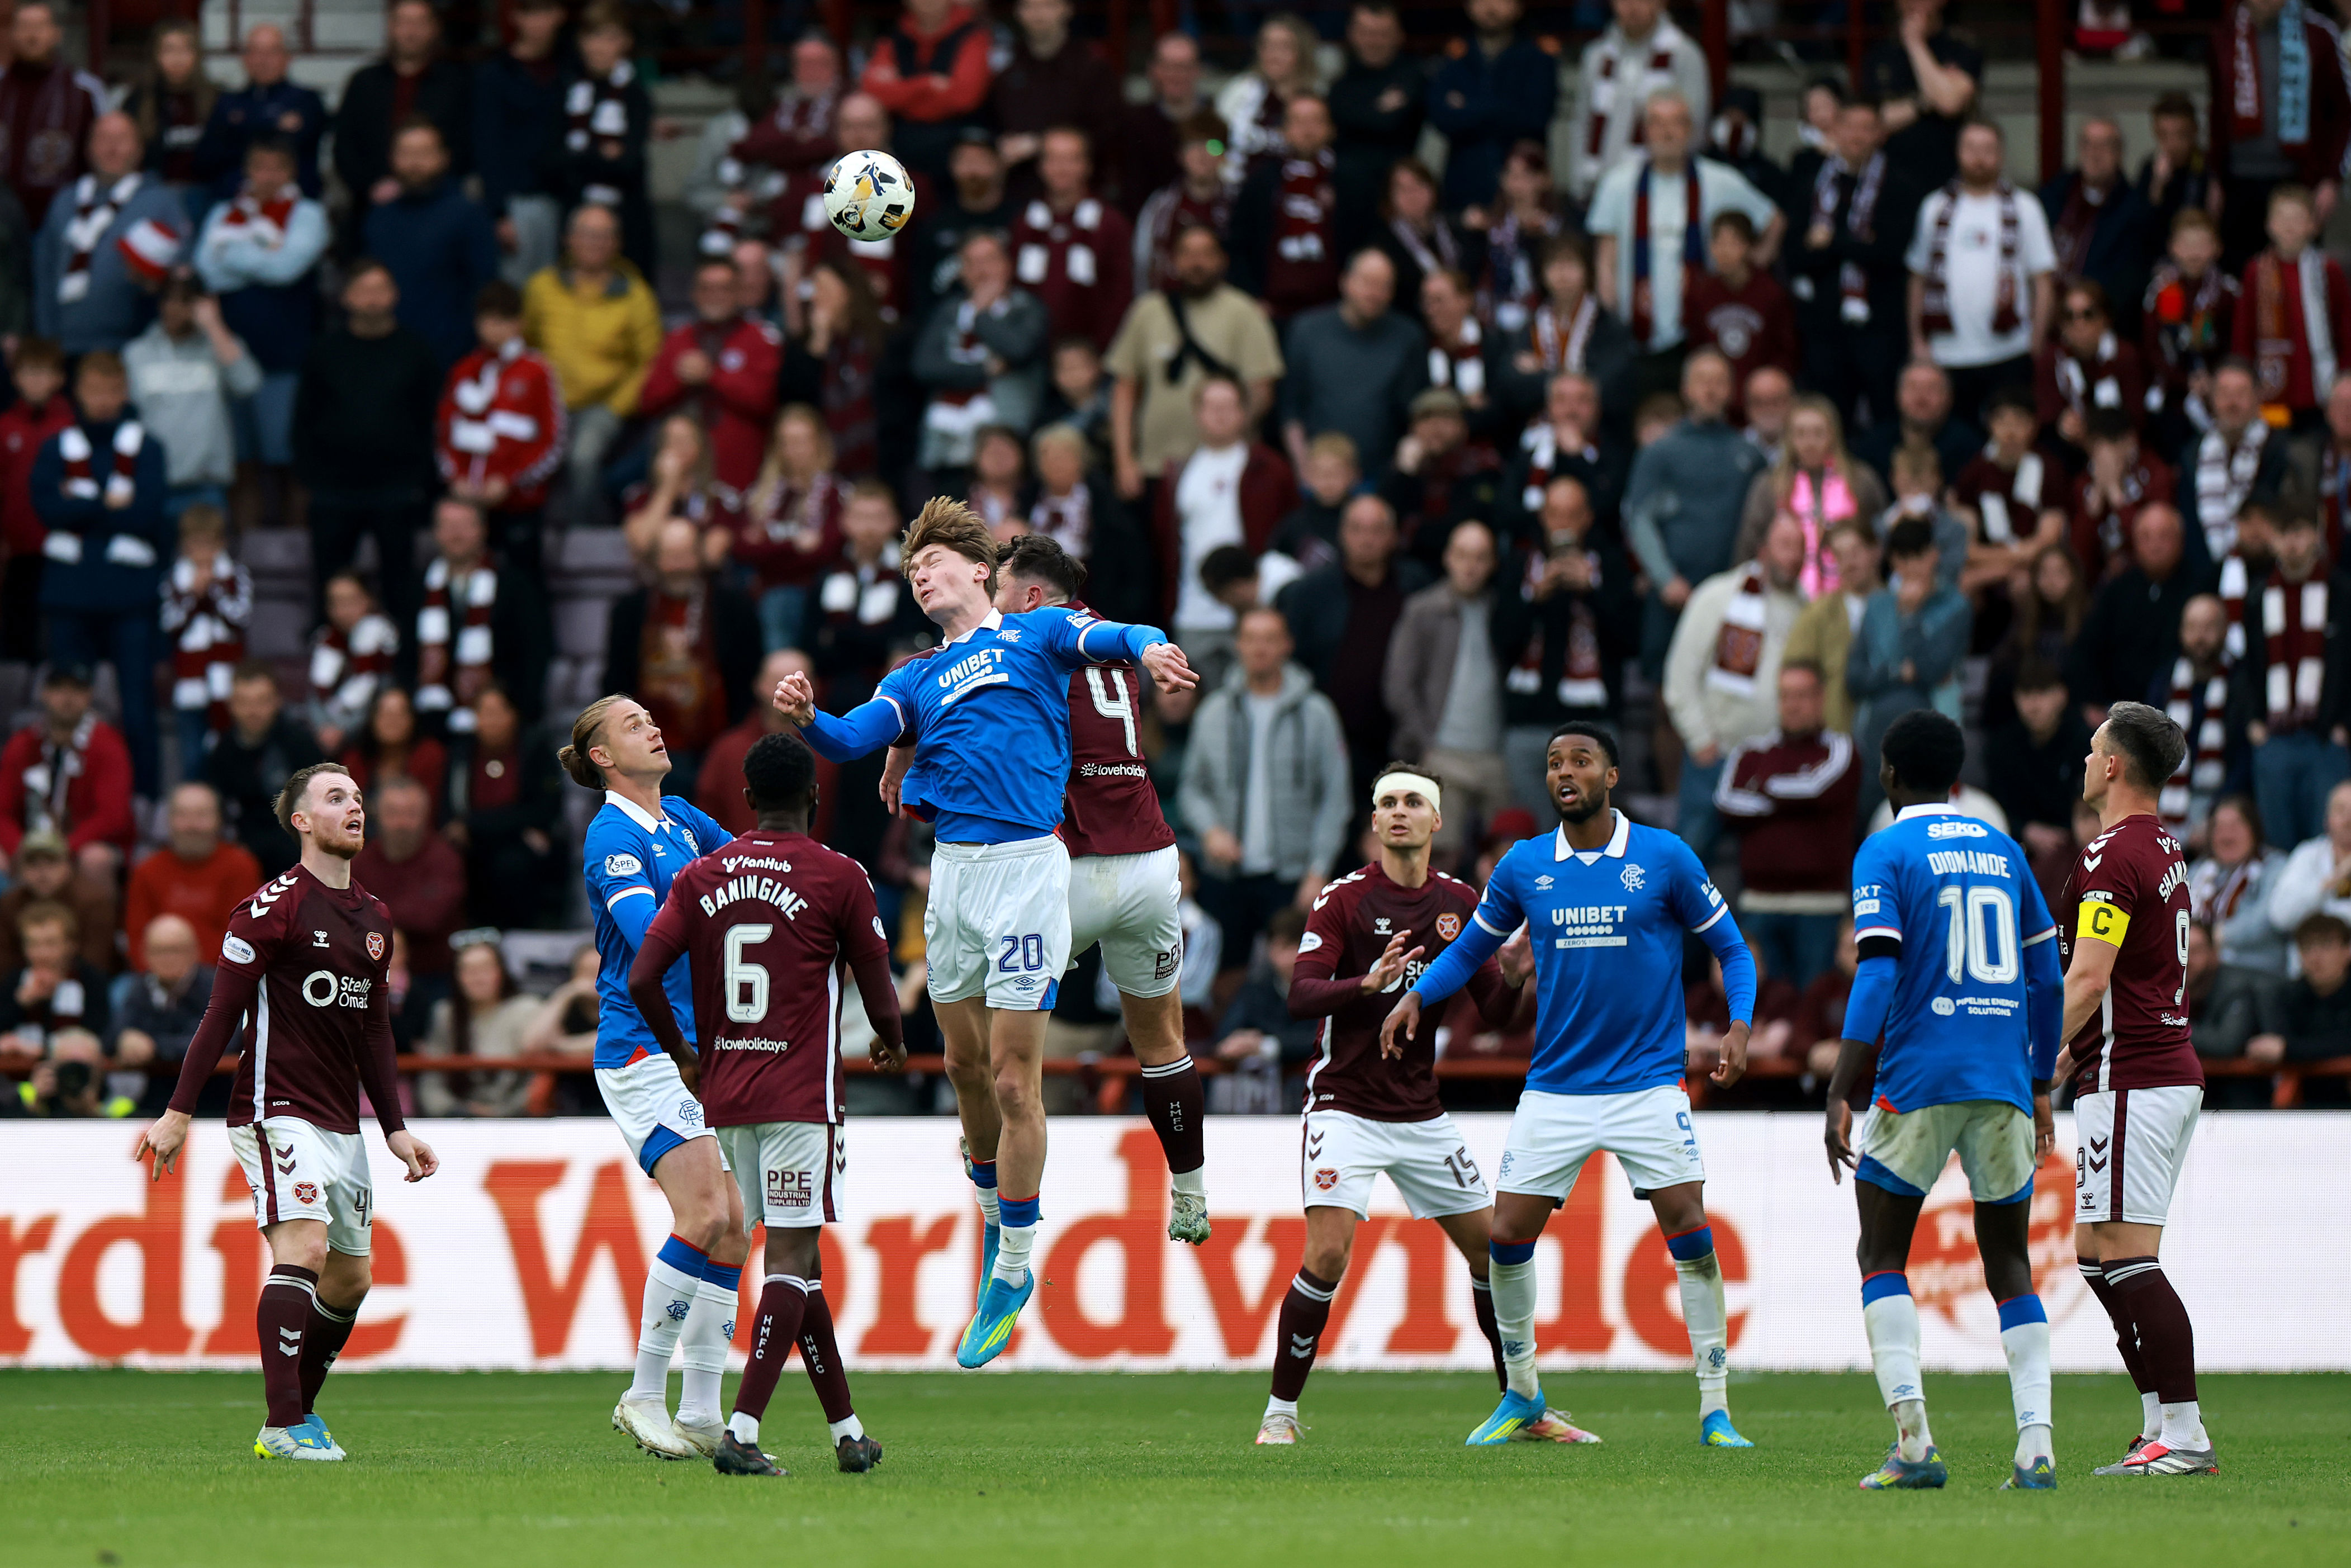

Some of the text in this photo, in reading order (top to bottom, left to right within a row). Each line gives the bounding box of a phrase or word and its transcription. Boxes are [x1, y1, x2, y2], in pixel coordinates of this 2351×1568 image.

[938, 648, 1005, 688] UNIBET
[1086, 666, 1137, 757] 4
[1927, 821, 1985, 838] SEKO
[615, 860, 636, 869] SPFL
[741, 856, 792, 873] fanHub
[1926, 850, 2011, 879] DIOMANDE
[699, 874, 809, 921] BANINGIME
[1551, 905, 1628, 926] UNIBET
[2092, 906, 2113, 936] C
[1937, 884, 2019, 985] 10
[998, 934, 1043, 972] 20
[2173, 908, 2191, 1006] 9
[724, 923, 774, 1024] 6
[1956, 997, 1990, 1006] PIPELINE
[1968, 1006, 2012, 1017] SOLUTIONS
[722, 1036, 788, 1054] loveholidays
[1676, 1111, 1695, 1145] 9
[767, 1170, 812, 1190] PPE
[1444, 1145, 1480, 1188] 15
[768, 1190, 810, 1199] INDUSTRIAL
[755, 1314, 773, 1359] HMFC
[804, 1334, 825, 1374] HMFC
